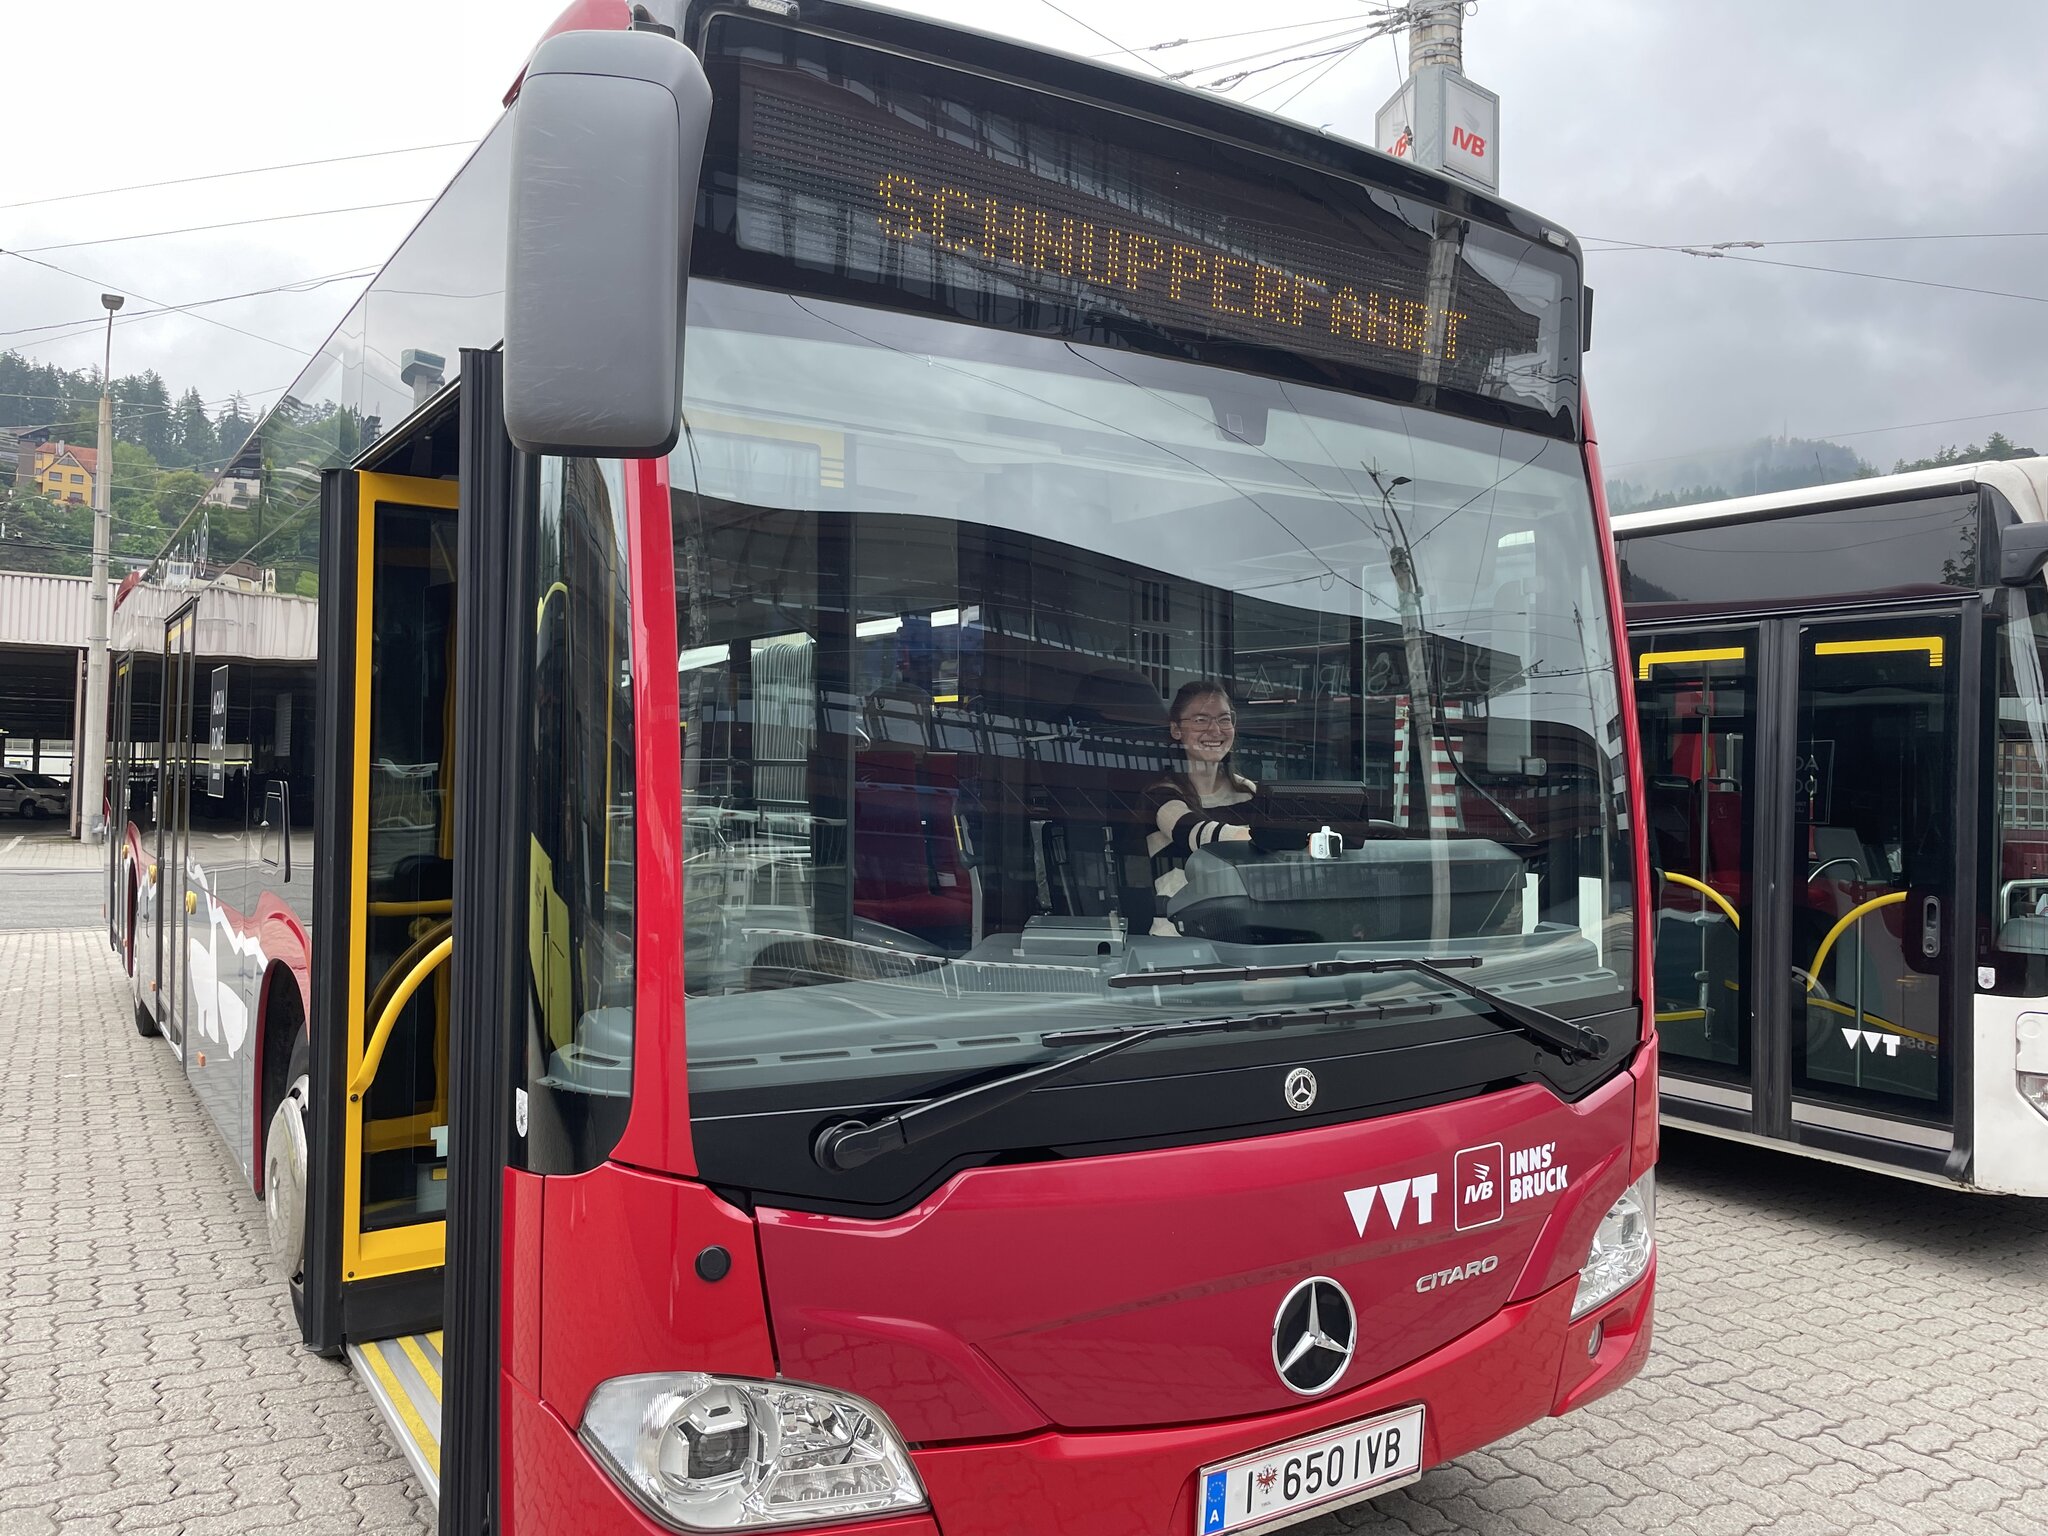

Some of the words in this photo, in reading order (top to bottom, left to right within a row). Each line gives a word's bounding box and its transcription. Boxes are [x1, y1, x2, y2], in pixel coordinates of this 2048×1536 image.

[1452, 126, 1485, 158] IVB
[877, 172, 1468, 360] SCHNUPPERFAHRT
[1841, 1027, 1901, 1057] VVT
[1464, 1180, 1494, 1205] IVB
[1509, 1165, 1569, 1204] BRUCK
[1343, 1173, 1438, 1238] VVT
[1416, 1255, 1499, 1294] CITARO
[1245, 1470, 1254, 1515] I
[1283, 1445, 1345, 1501] 650
[1353, 1427, 1401, 1480] IVB
[1209, 1509, 1220, 1525] A
